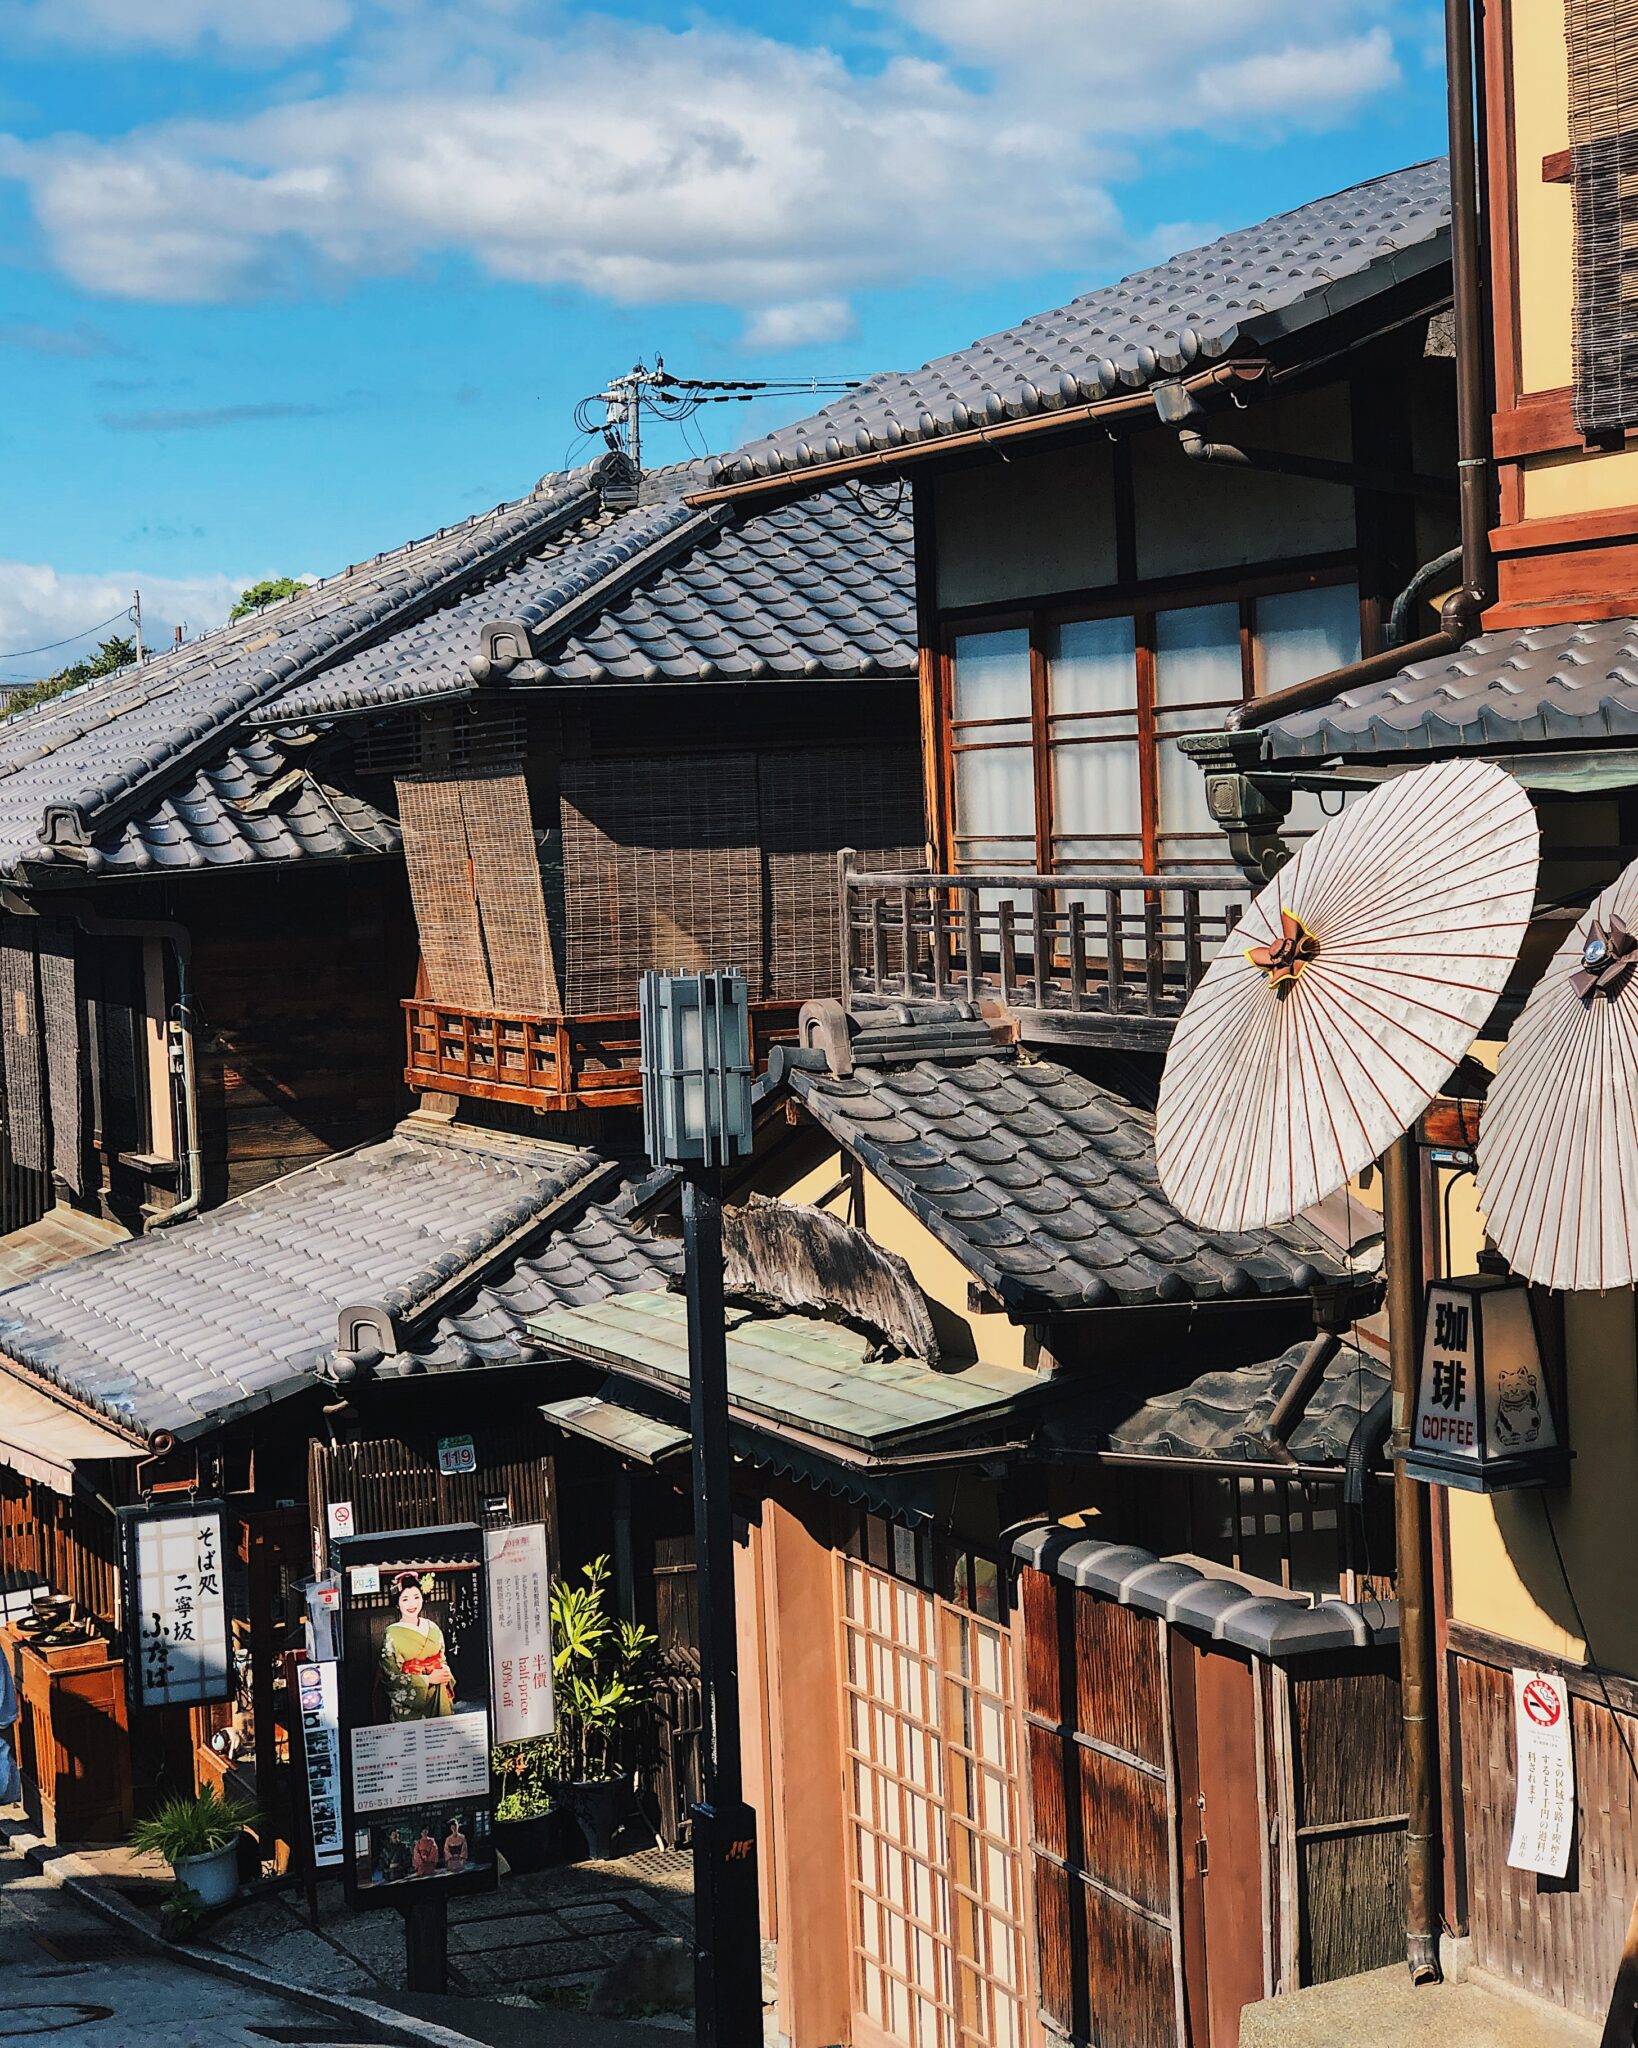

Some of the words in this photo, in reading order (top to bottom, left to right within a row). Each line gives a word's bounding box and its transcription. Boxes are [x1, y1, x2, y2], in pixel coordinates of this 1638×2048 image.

[1431, 1302, 1469, 1412] 珈琲
[1422, 1415, 1474, 1446] COFFEE
[442, 1449, 472, 1467] 119
[197, 1527, 219, 1596] そば処
[174, 1574, 196, 1641] 二寧坂
[142, 1613, 174, 1689] ふたば
[501, 1660, 513, 1688] 50%
[503, 1692, 514, 1707] off
[518, 1656, 530, 1718] half-price.
[357, 1794, 418, 1810] 075-531-2777
